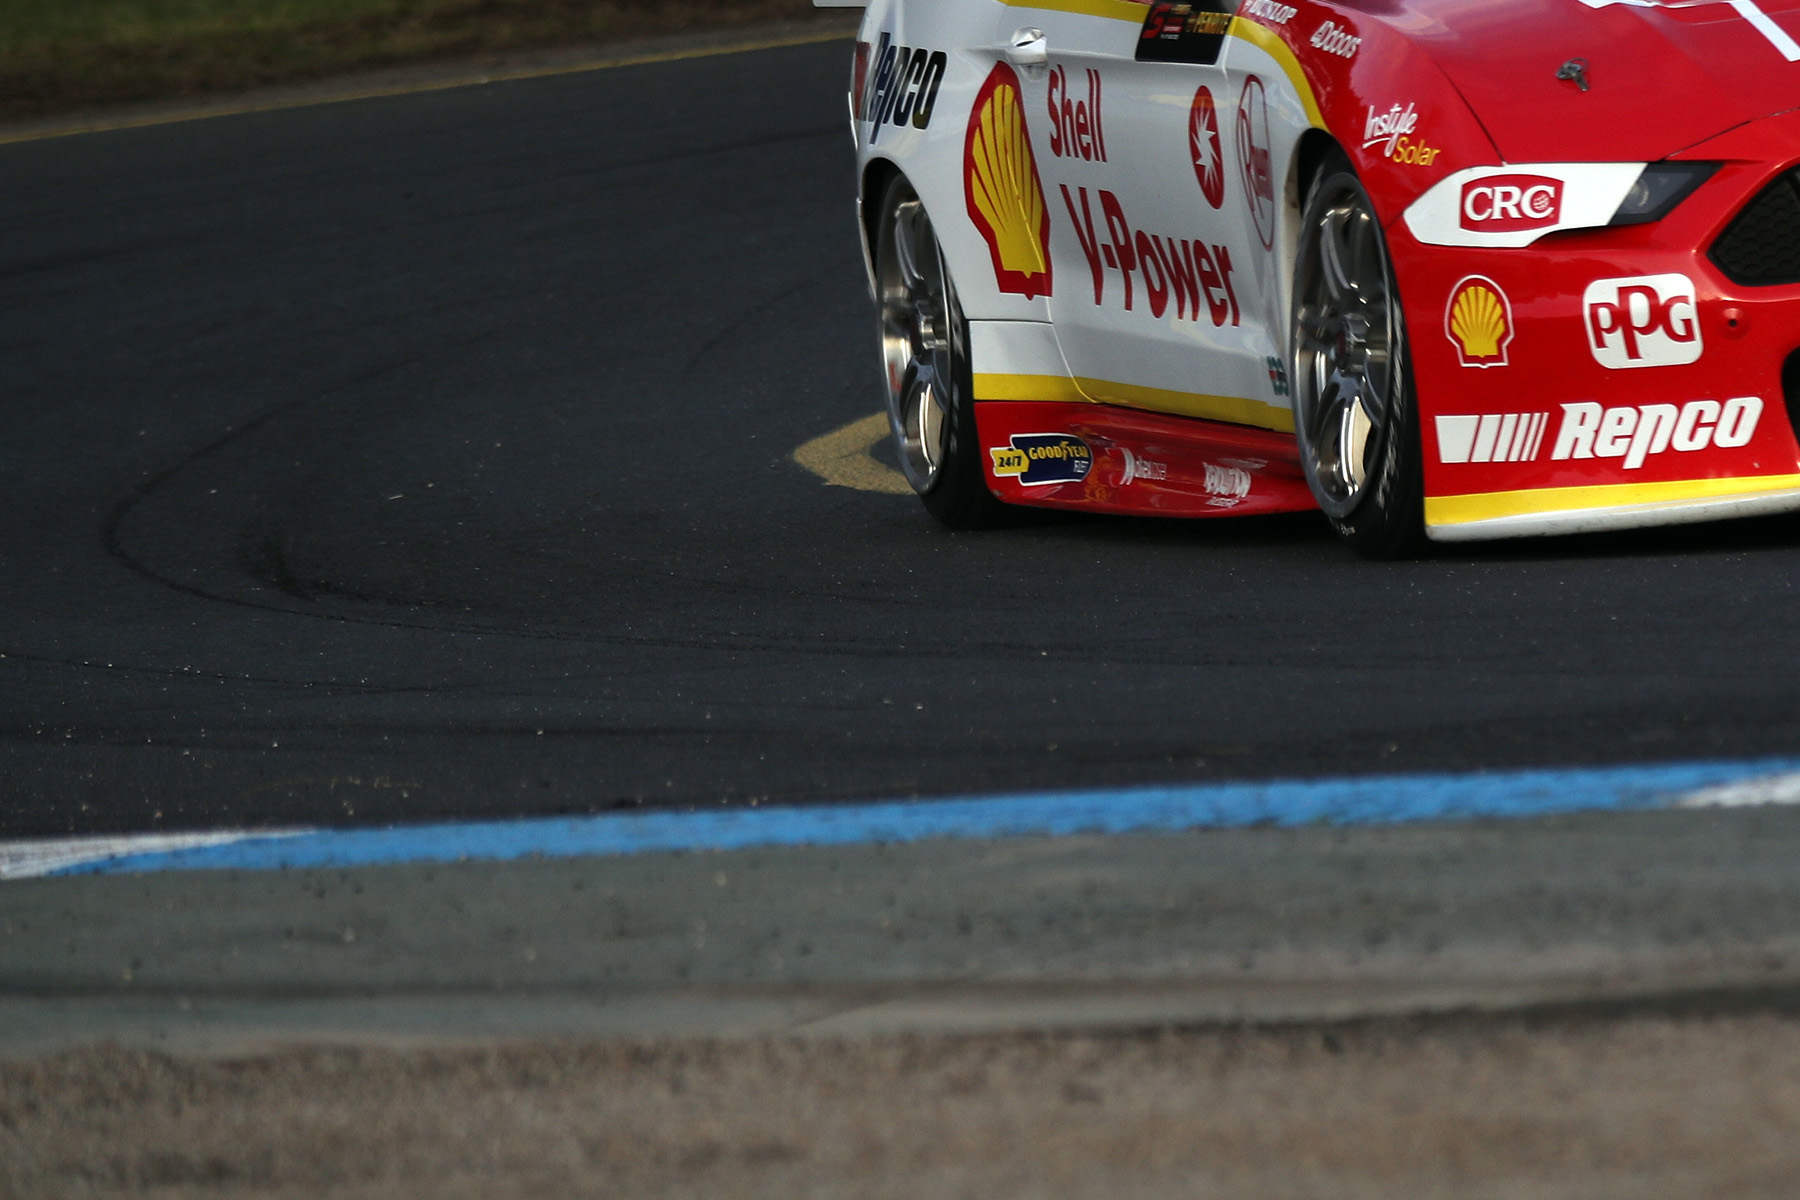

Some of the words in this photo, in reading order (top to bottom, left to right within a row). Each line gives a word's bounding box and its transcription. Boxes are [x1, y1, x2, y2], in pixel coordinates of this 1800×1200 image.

[1048, 64, 1107, 162] Shell
[1362, 102, 1418, 157] Instyle
[1393, 136, 1441, 166] Solar
[1465, 184, 1555, 221] CRC
[1059, 183, 1240, 327] V-Power
[1551, 397, 1763, 469] Repco
[999, 456, 1022, 468] 24/7
